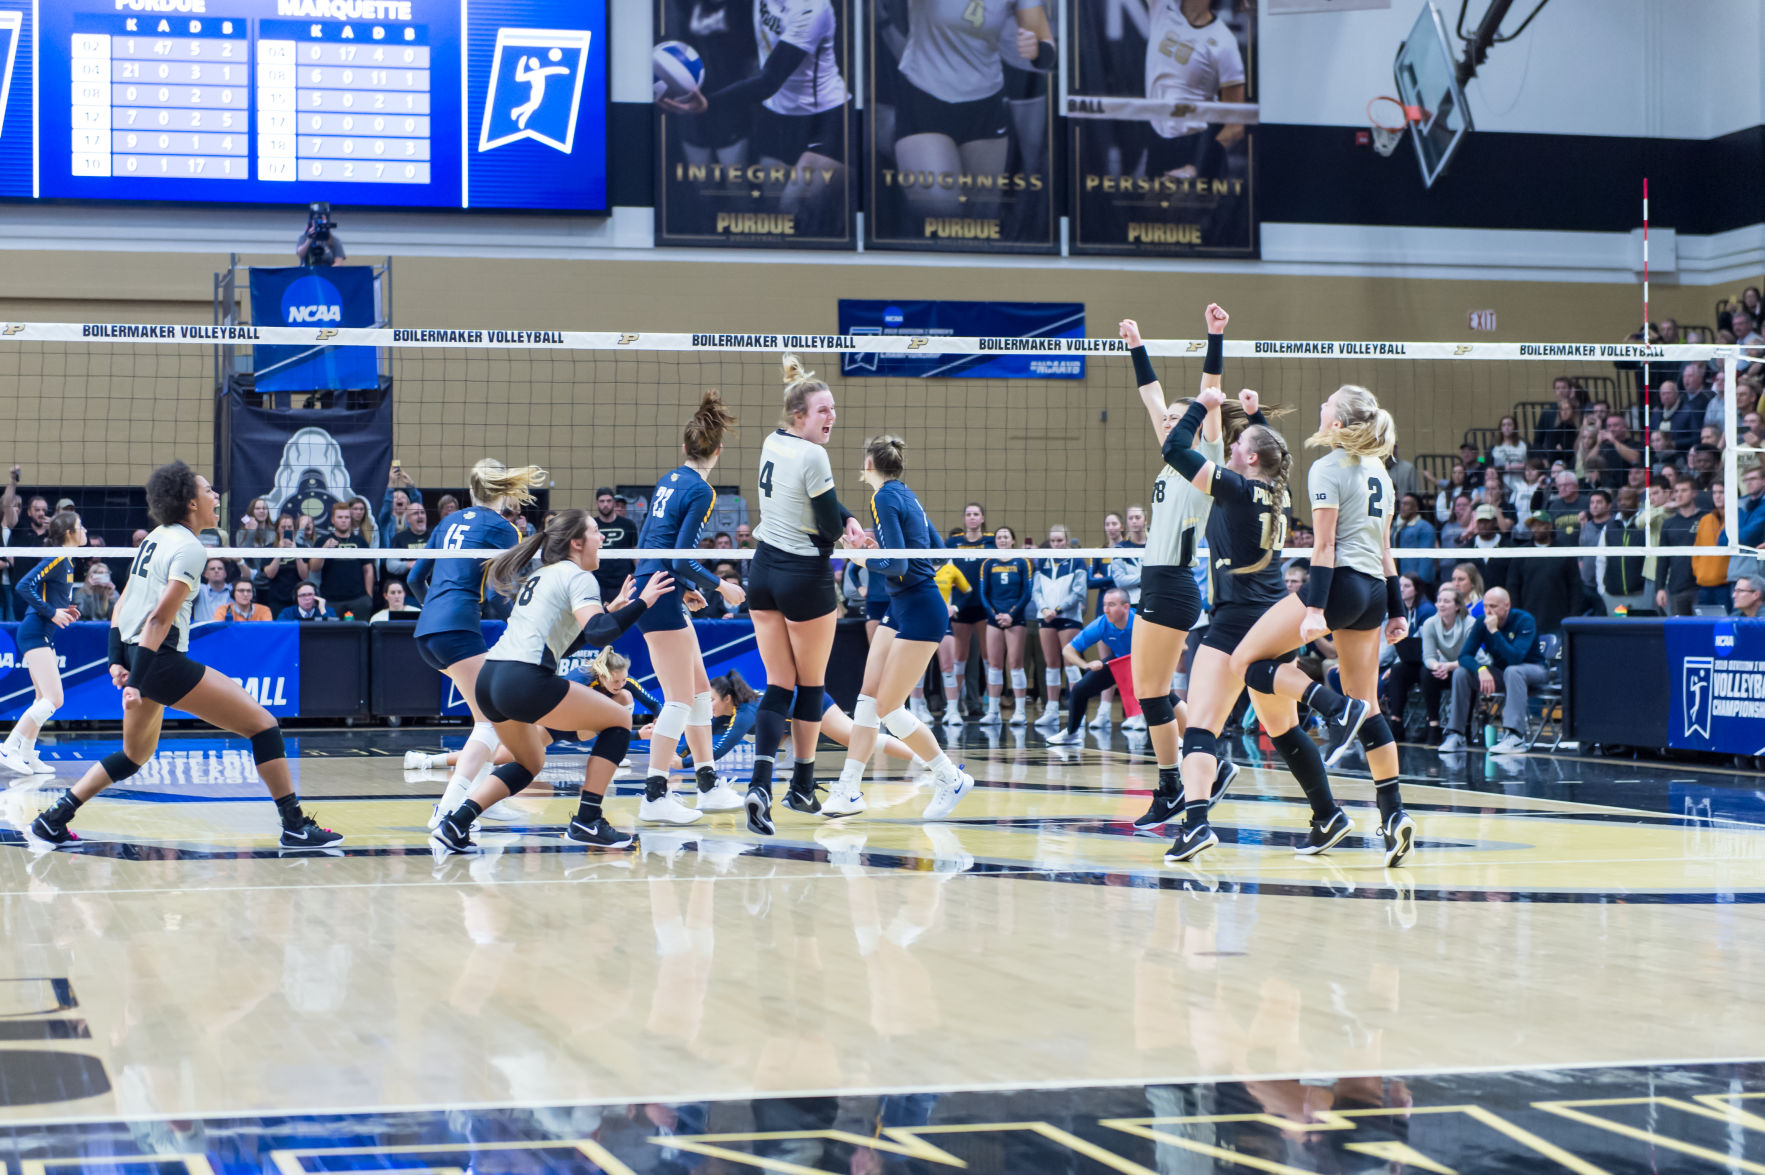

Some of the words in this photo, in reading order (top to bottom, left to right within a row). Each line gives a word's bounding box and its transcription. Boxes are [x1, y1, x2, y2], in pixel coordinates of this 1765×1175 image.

[278, 0, 412, 20] MARQUETTE
[153, 40, 172, 55] 47
[339, 47, 357, 62] 17
[122, 63, 139, 78] 21
[371, 71, 387, 86] 11
[188, 159, 205, 173] 17
[676, 163, 835, 185] INTEGRITY
[883, 169, 1043, 191] TOUGHNESS
[1086, 175, 1244, 195] PERSISTENT
[717, 212, 795, 234] PURDUE
[924, 217, 1000, 239] PURDUE
[1128, 222, 1202, 244] PURDUE
[288, 304, 341, 323] NCAA
[1469, 311, 1494, 330] EXIT
[82, 324, 176, 339] BOILERMAKER
[180, 325, 260, 340] VOLLEYBALL
[393, 329, 483, 343] BOILERMAKER
[487, 330, 564, 344] VOLLEYBALL
[692, 333, 778, 348] BOILERMAKER
[782, 335, 856, 349] VOLLEYBALL
[979, 338, 1062, 351] BOILERMAKER
[1066, 339, 1132, 352] VOLLEYBAL
[1254, 342, 1334, 354] BOILERMAKER
[1338, 343, 1406, 355] VOLLEYBALL
[1519, 344, 1595, 357] BOILERMAKER
[1600, 345, 1664, 357] VOLLEYBALL
[760, 460, 775, 498] 4
[652, 486, 675, 519] 23
[1367, 476, 1383, 518] 2
[443, 523, 471, 549] 15
[132, 540, 158, 578] 12
[1000, 572, 1009, 584] 5
[519, 576, 541, 606] 8
